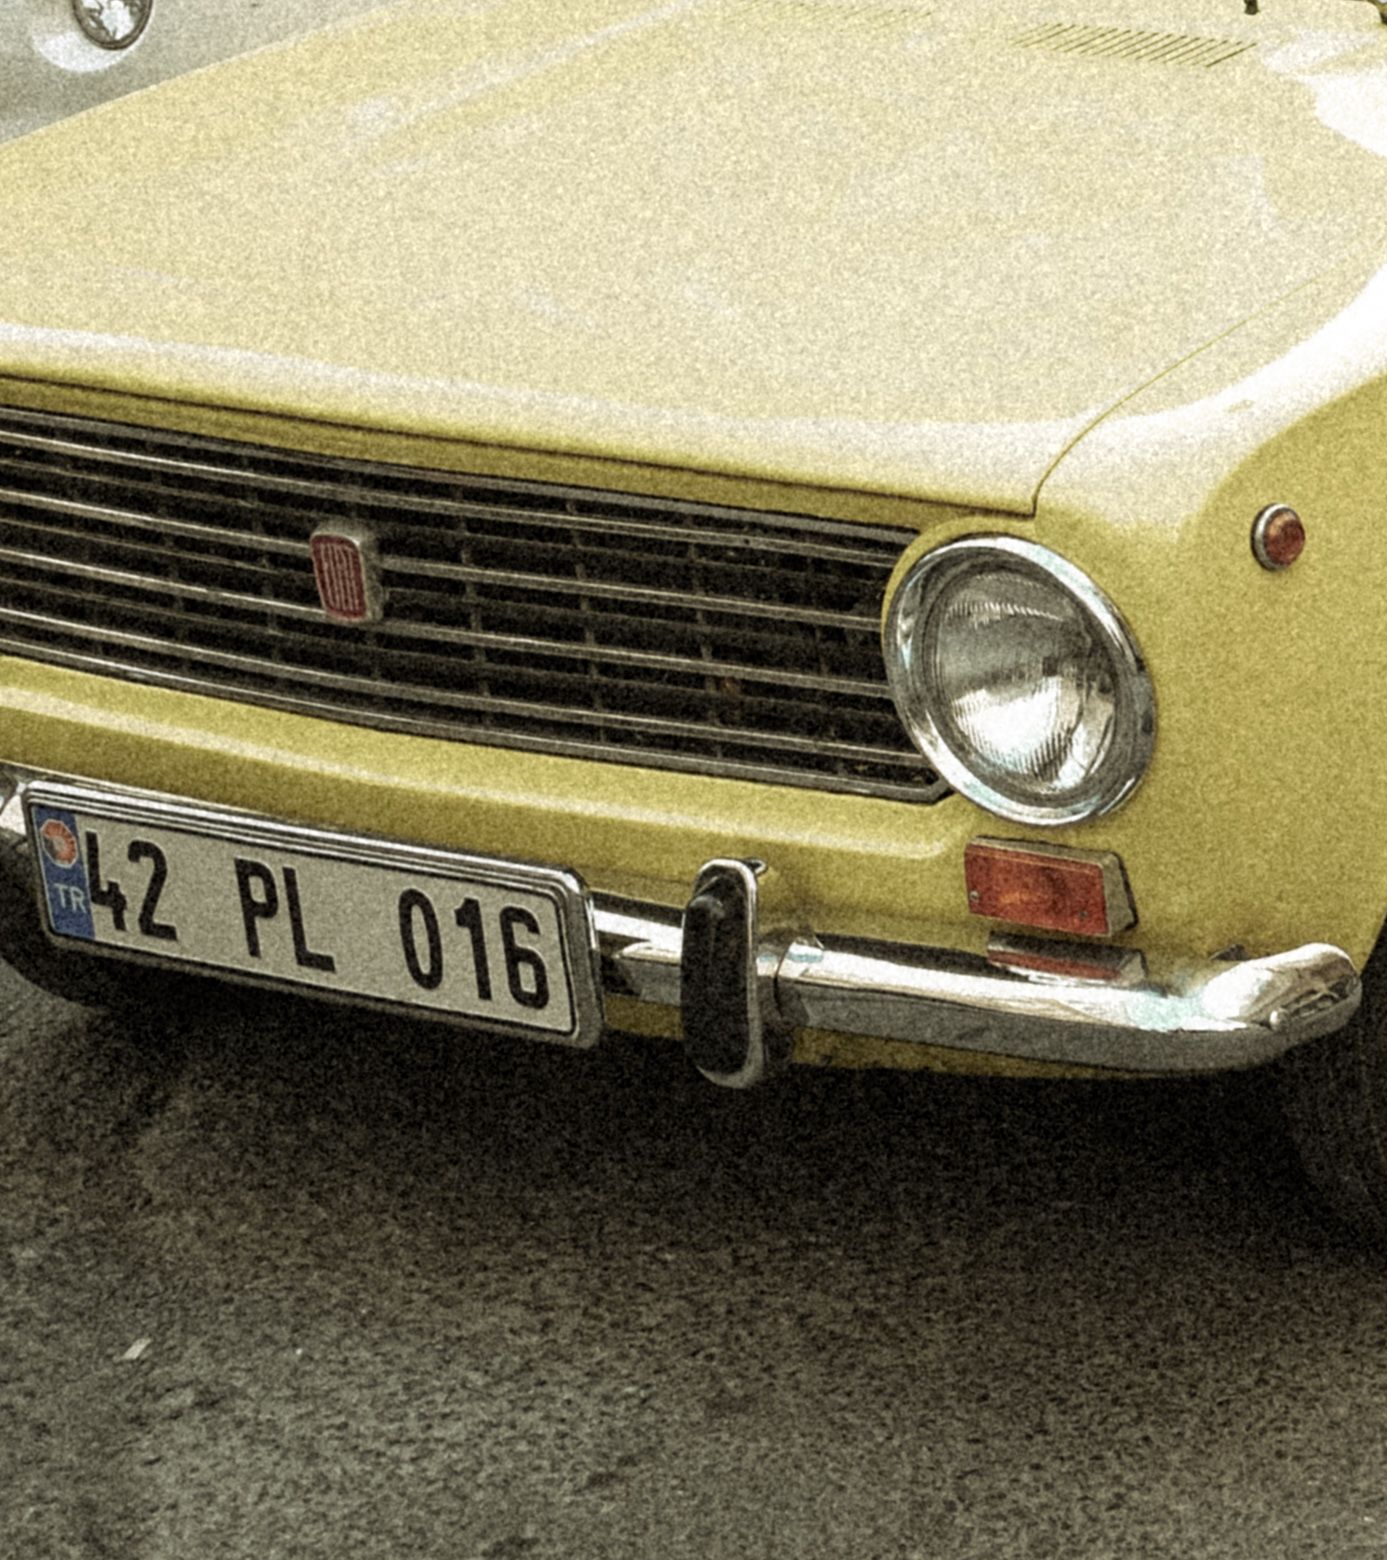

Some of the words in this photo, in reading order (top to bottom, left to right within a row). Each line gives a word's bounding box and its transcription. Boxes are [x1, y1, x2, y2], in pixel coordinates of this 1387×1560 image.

[53, 882, 87, 914] TR
[85, 829, 178, 942] 42
[234, 855, 336, 973] PL
[398, 887, 550, 1010] 016
